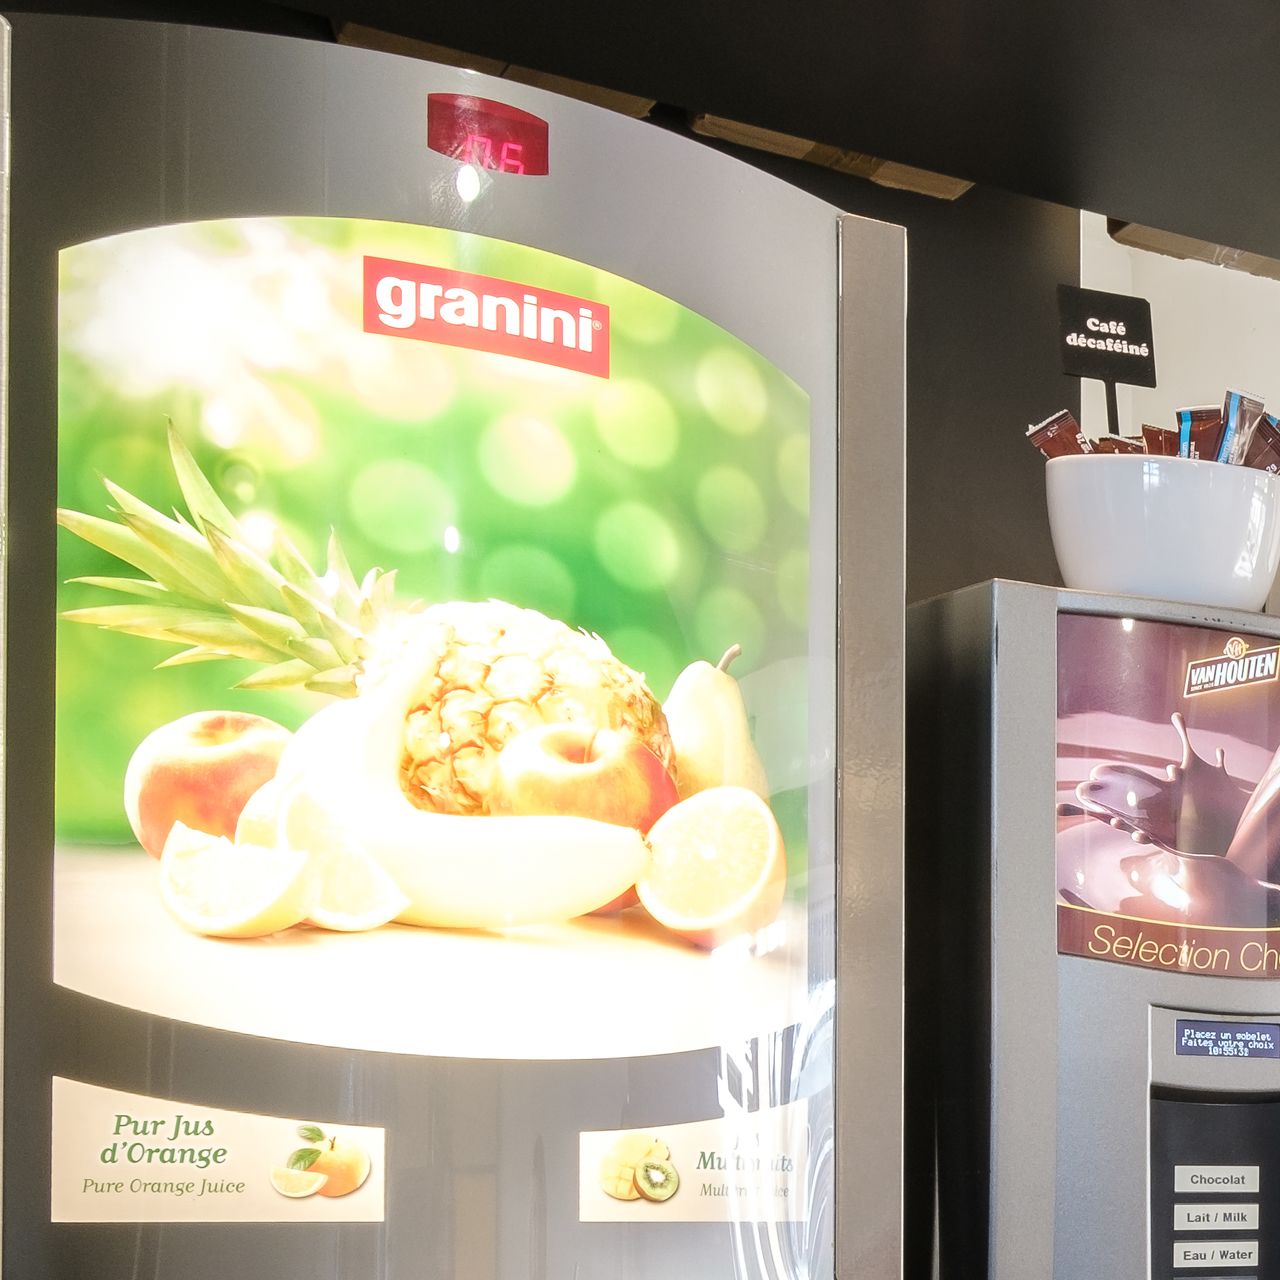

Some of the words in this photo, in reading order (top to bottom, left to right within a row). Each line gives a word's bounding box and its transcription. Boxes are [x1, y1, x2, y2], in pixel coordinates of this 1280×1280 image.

[375, 276, 593, 353] granini
[1086, 317, 1126, 336] Café
[1066, 332, 1149, 357] décaféiné
[1088, 924, 1230, 970] Selection
[1184, 1029, 1216, 1040] Placez
[1220, 1032, 1232, 1040] un
[1248, 1040, 1275, 1050] choix
[112, 1114, 166, 1137] Pur
[169, 1115, 215, 1141] Jus
[100, 1142, 228, 1169] d'Orange
[82, 1179, 125, 1194] Pure
[129, 1178, 196, 1197] Orange
[196, 1179, 246, 1197] Juice
[1190, 1174, 1246, 1185] Chocolat
[1186, 1212, 1210, 1223] Lait
[1222, 1212, 1248, 1223] Milk
[1183, 1250, 1206, 1261] Eau
[1219, 1249, 1253, 1261] Water
